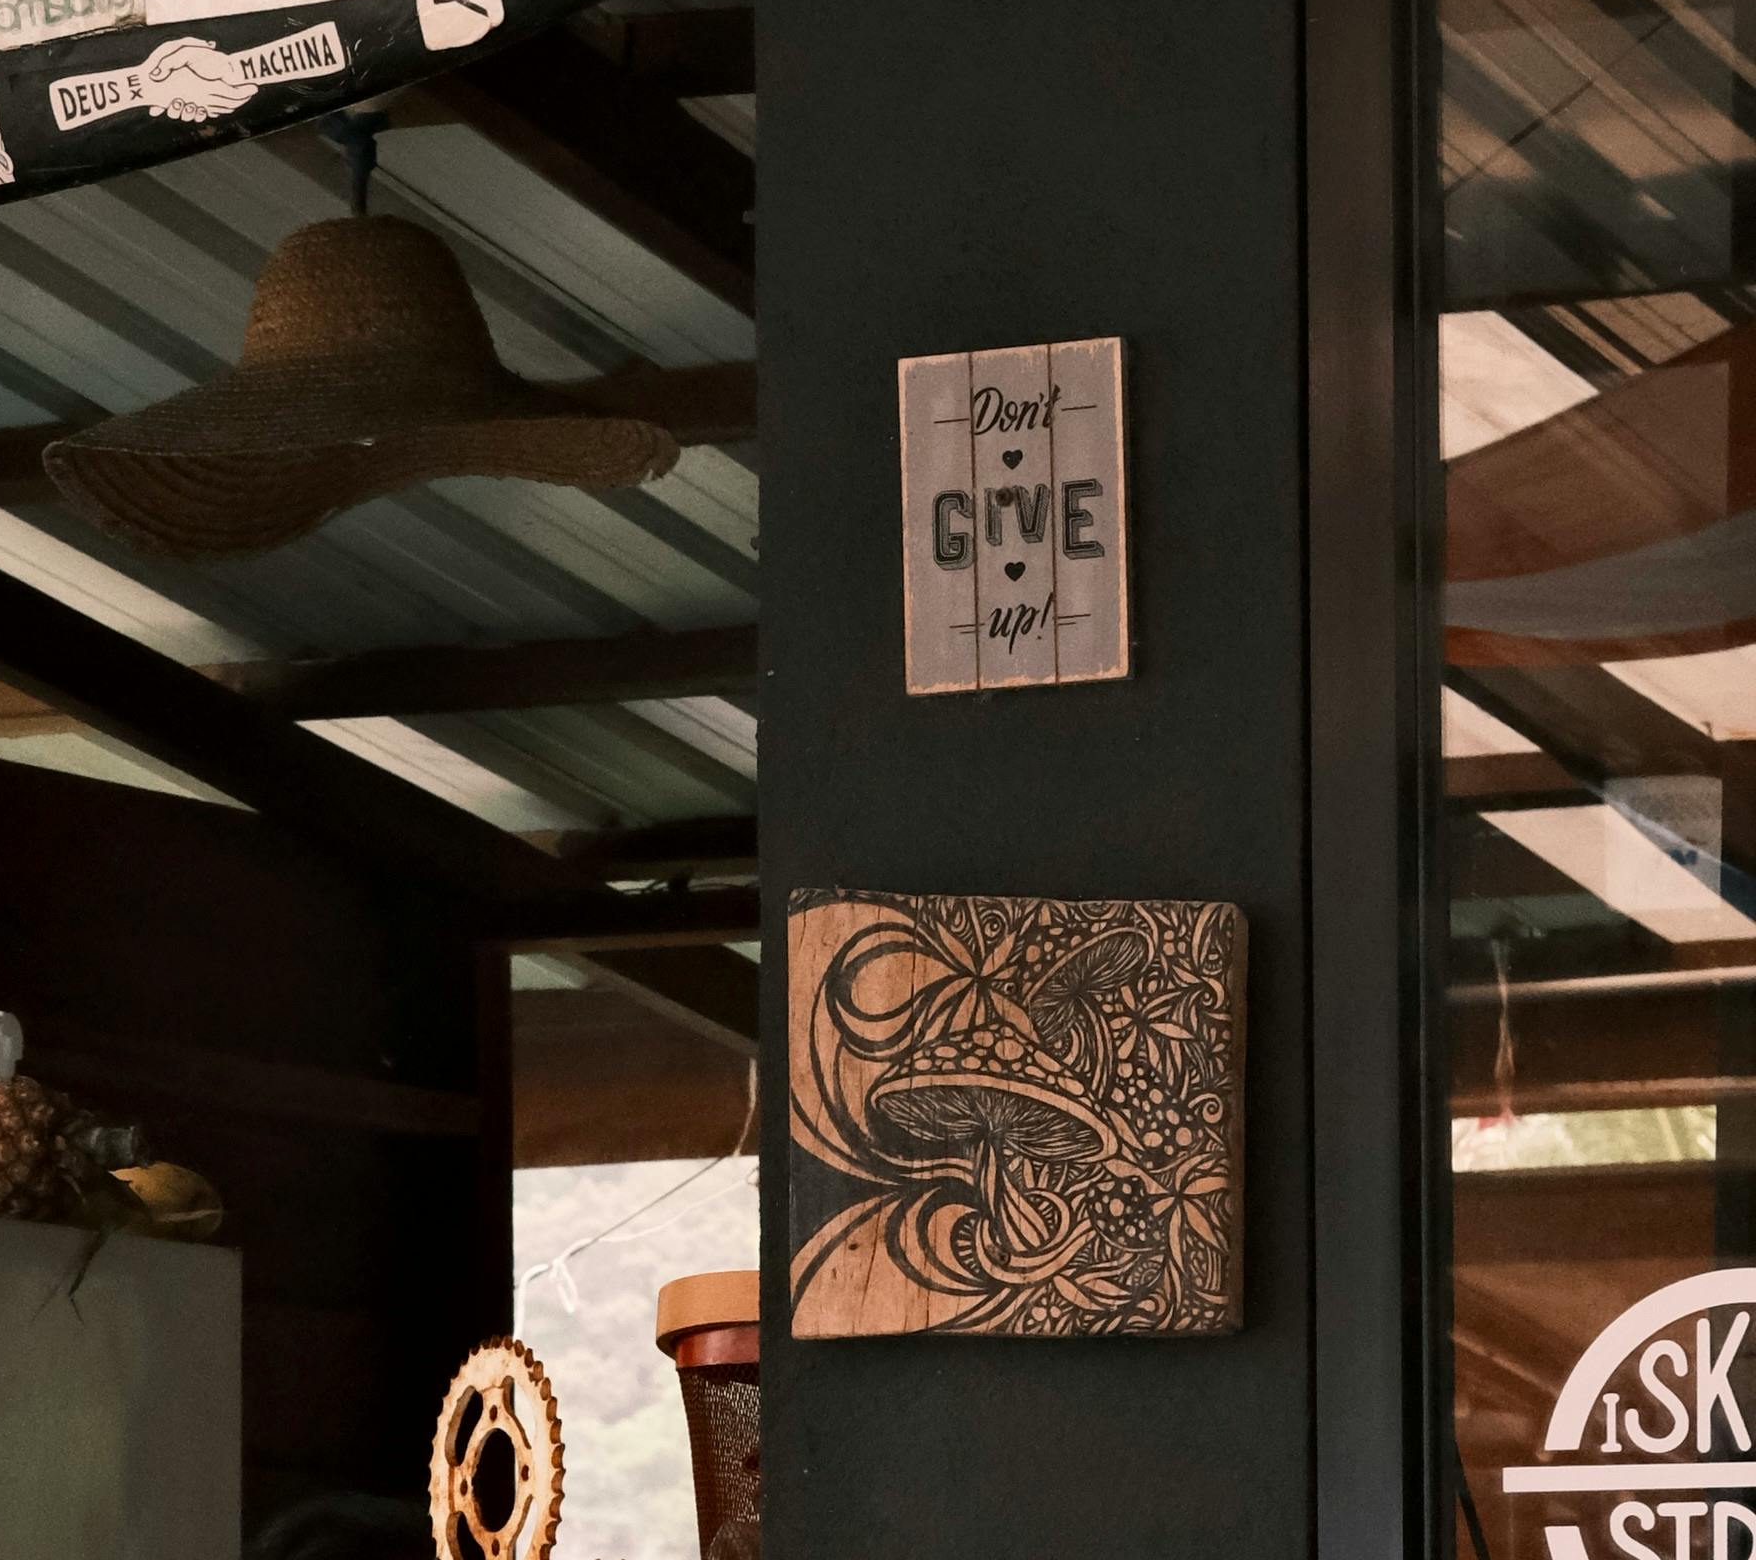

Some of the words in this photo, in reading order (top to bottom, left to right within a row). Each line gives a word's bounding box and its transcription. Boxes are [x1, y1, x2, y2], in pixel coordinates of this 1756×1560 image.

[57, 80, 121, 121] DEUS
[239, 32, 339, 80] MACHINA
[973, 383, 1062, 436] Don't
[932, 478, 1106, 572] GIVE
[987, 590, 1057, 655] up!
